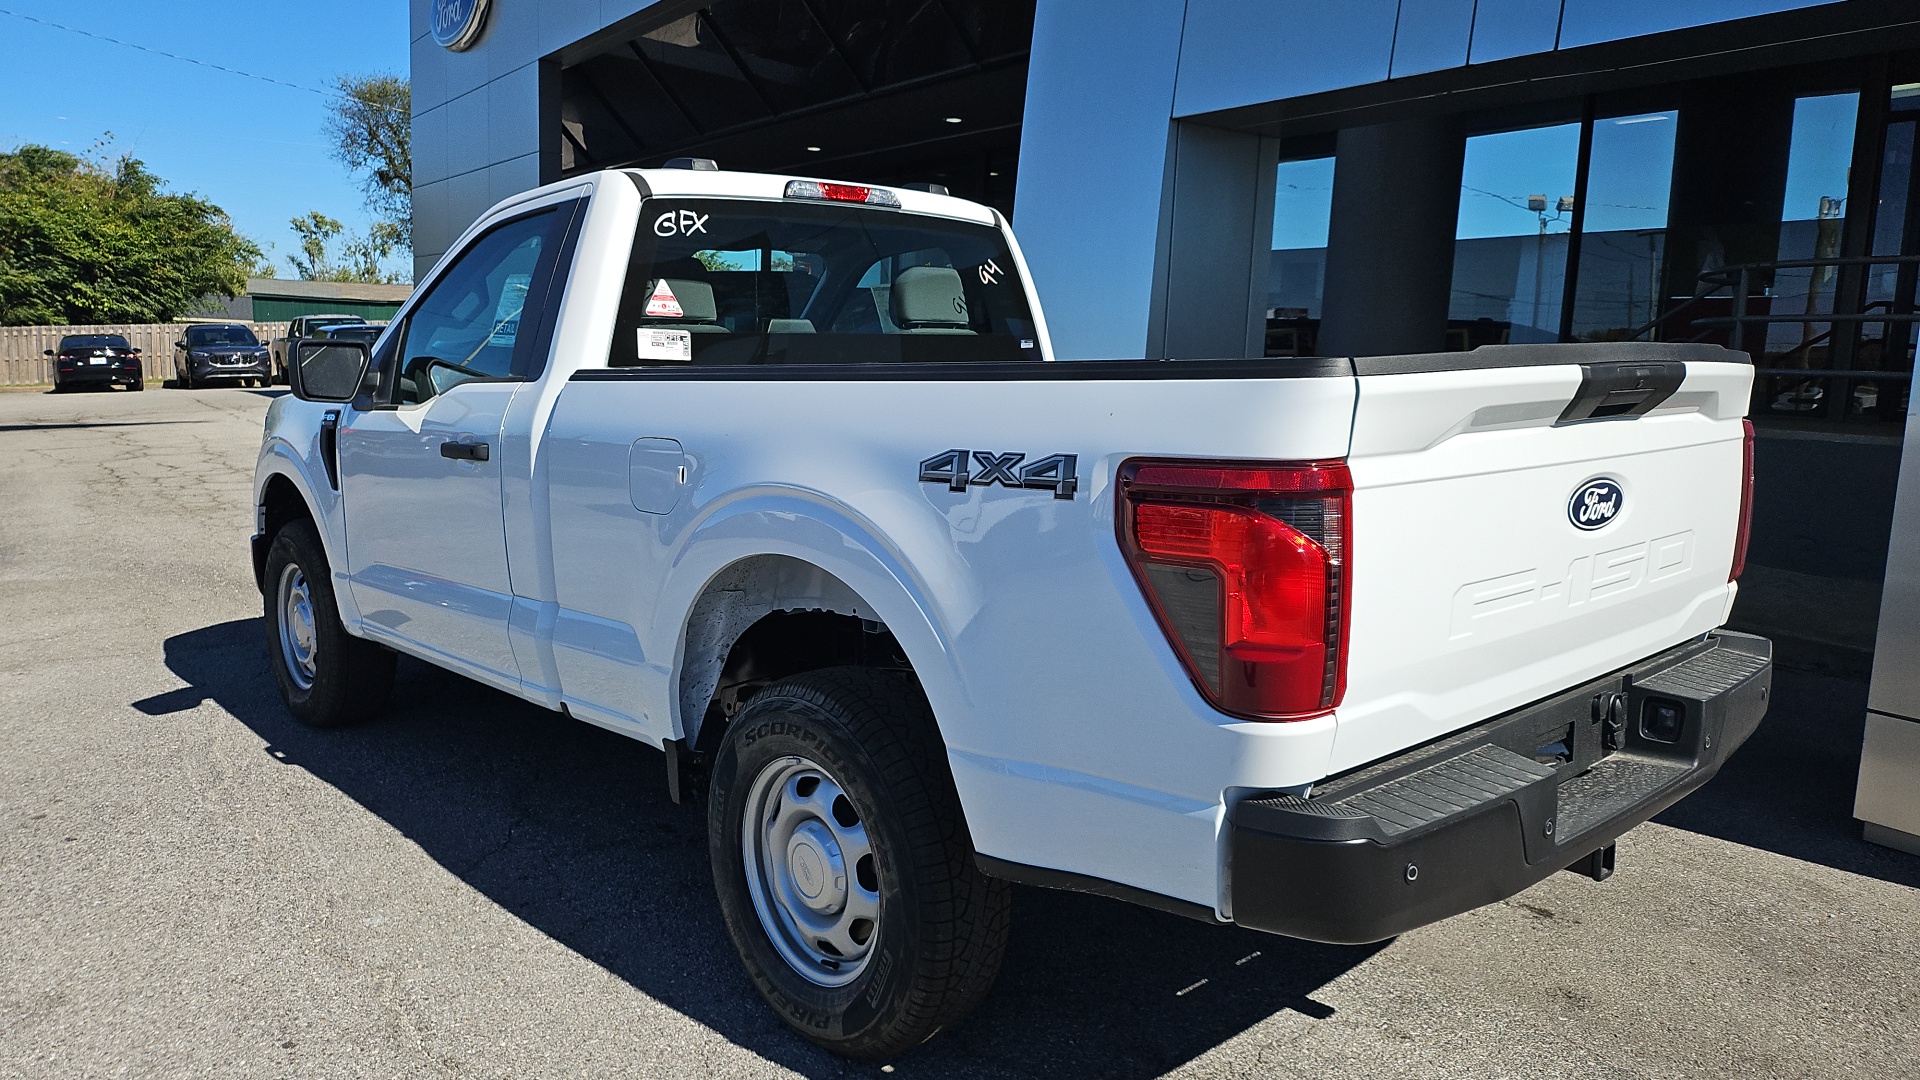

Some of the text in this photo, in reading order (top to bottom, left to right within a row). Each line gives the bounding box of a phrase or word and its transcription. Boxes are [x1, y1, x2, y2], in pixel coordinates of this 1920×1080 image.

[653, 209, 710, 237] GFX
[1579, 487, 1617, 523] Ford
[1448, 528, 1696, 641] F-150
[744, 720, 859, 787] SCORPION
